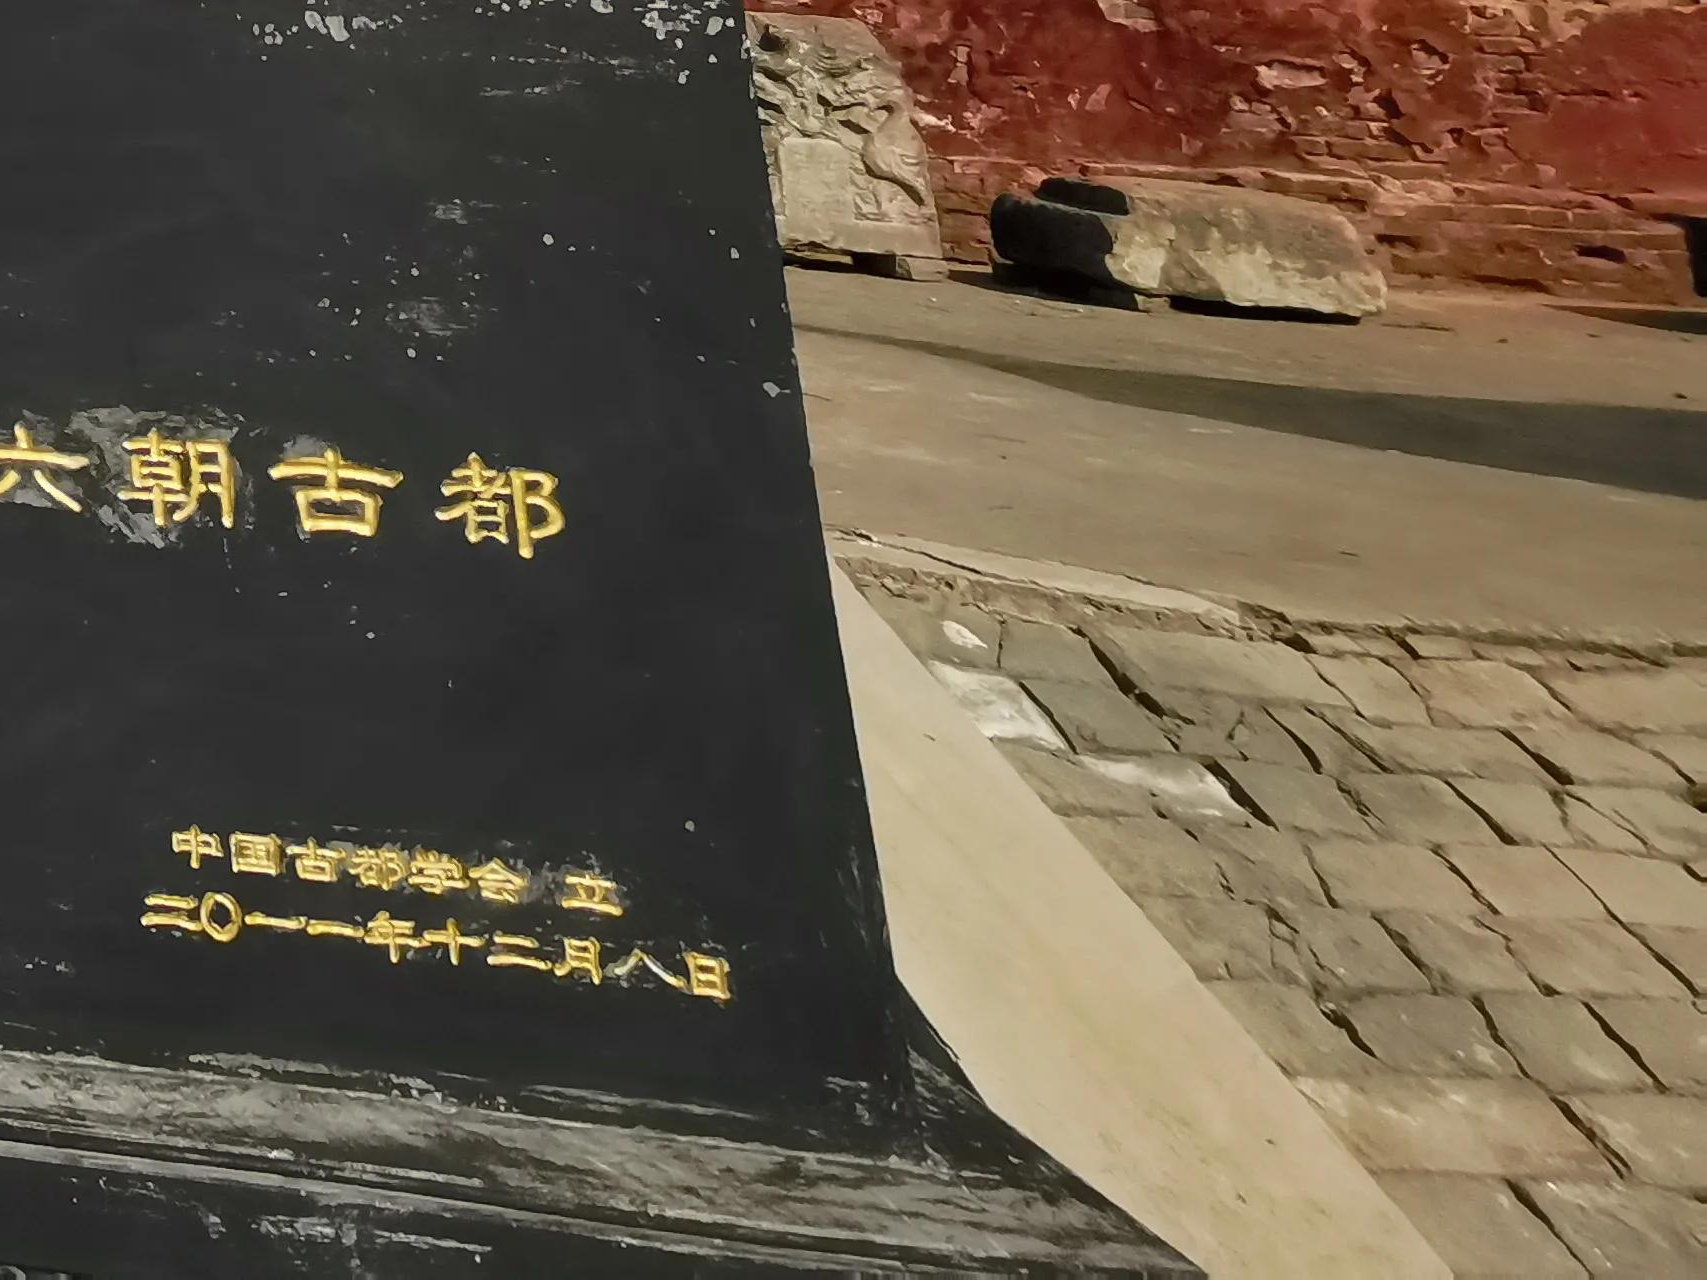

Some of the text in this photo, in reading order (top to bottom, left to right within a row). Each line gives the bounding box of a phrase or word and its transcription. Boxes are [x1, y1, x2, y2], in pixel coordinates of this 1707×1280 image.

[172, 824, 624, 917] 中国古都学会 立
